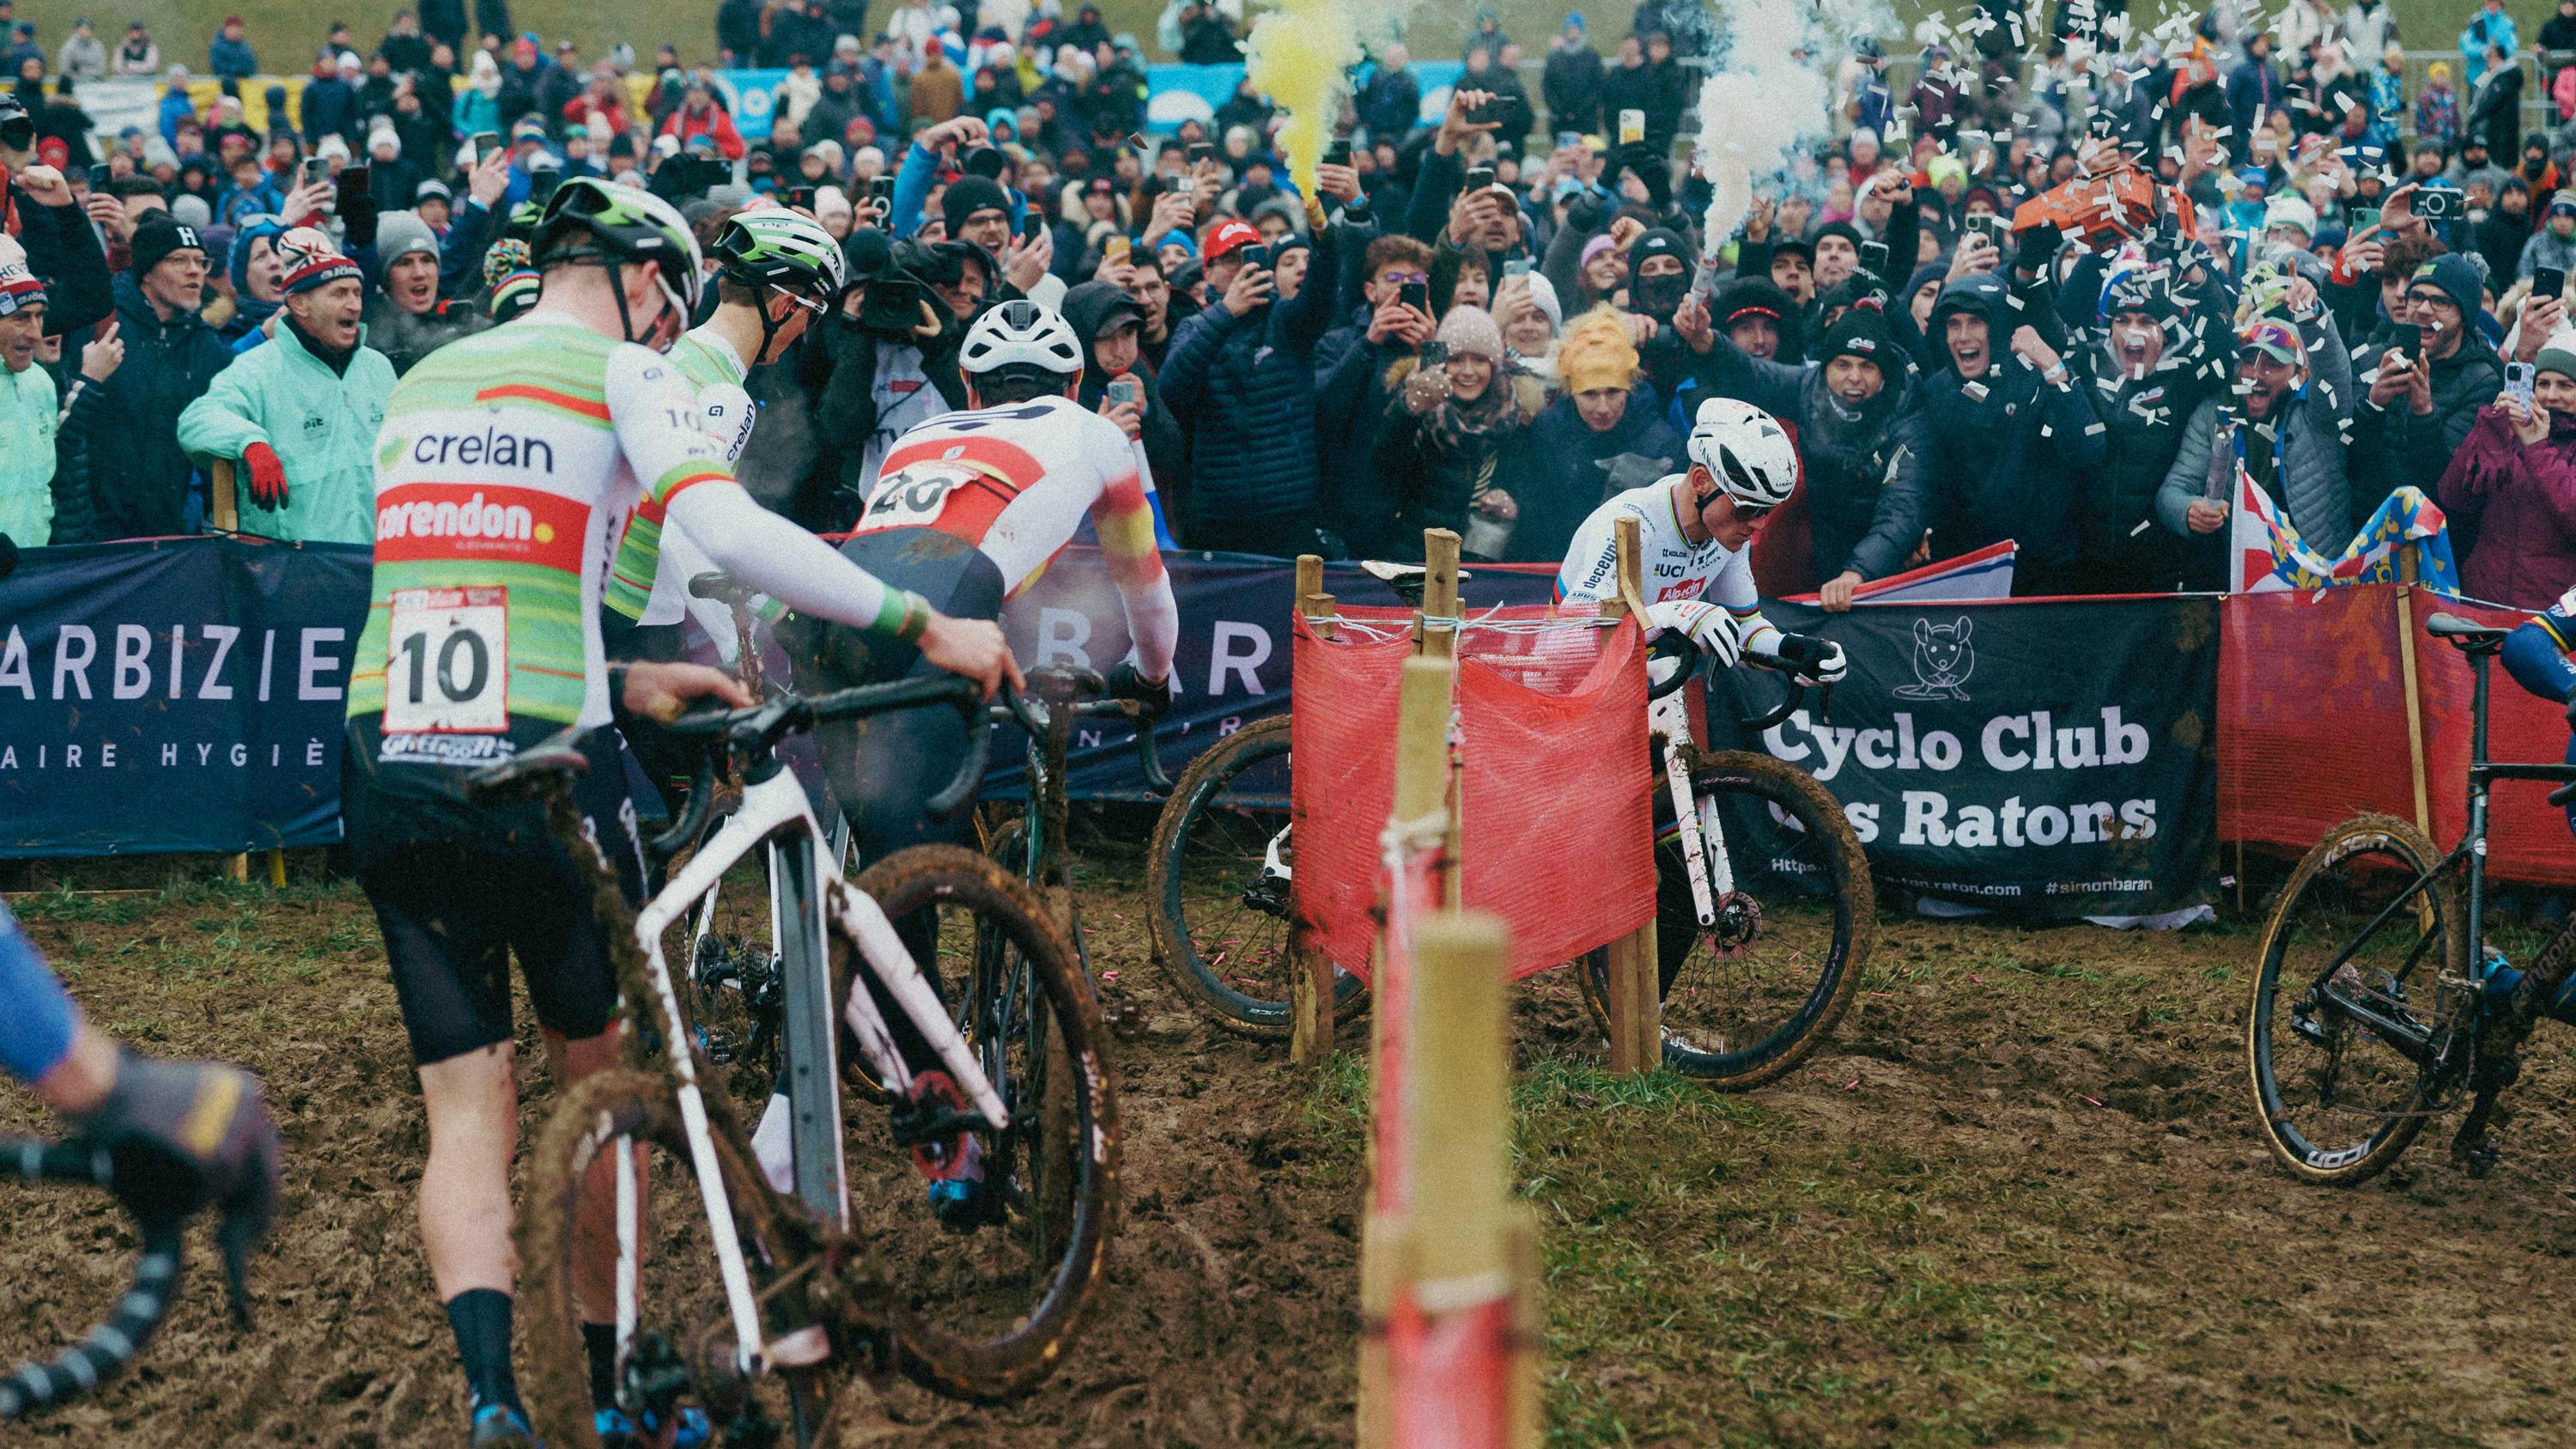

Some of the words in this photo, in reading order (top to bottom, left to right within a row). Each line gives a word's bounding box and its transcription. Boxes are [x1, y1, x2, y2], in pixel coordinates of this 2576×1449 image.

[177, 226, 198, 247] H
[414, 425, 553, 474] crelan
[726, 404, 755, 462] crelan
[868, 474, 954, 515] 20
[1659, 563, 1686, 578] UCI
[401, 628, 489, 703] 10
[1036, 606, 1273, 697] BR
[161, 737, 325, 767] HYGIÈ
[1762, 703, 1964, 782] Cyclo
[1980, 705, 2150, 772] Club
[1899, 789, 2157, 849] Ratons
